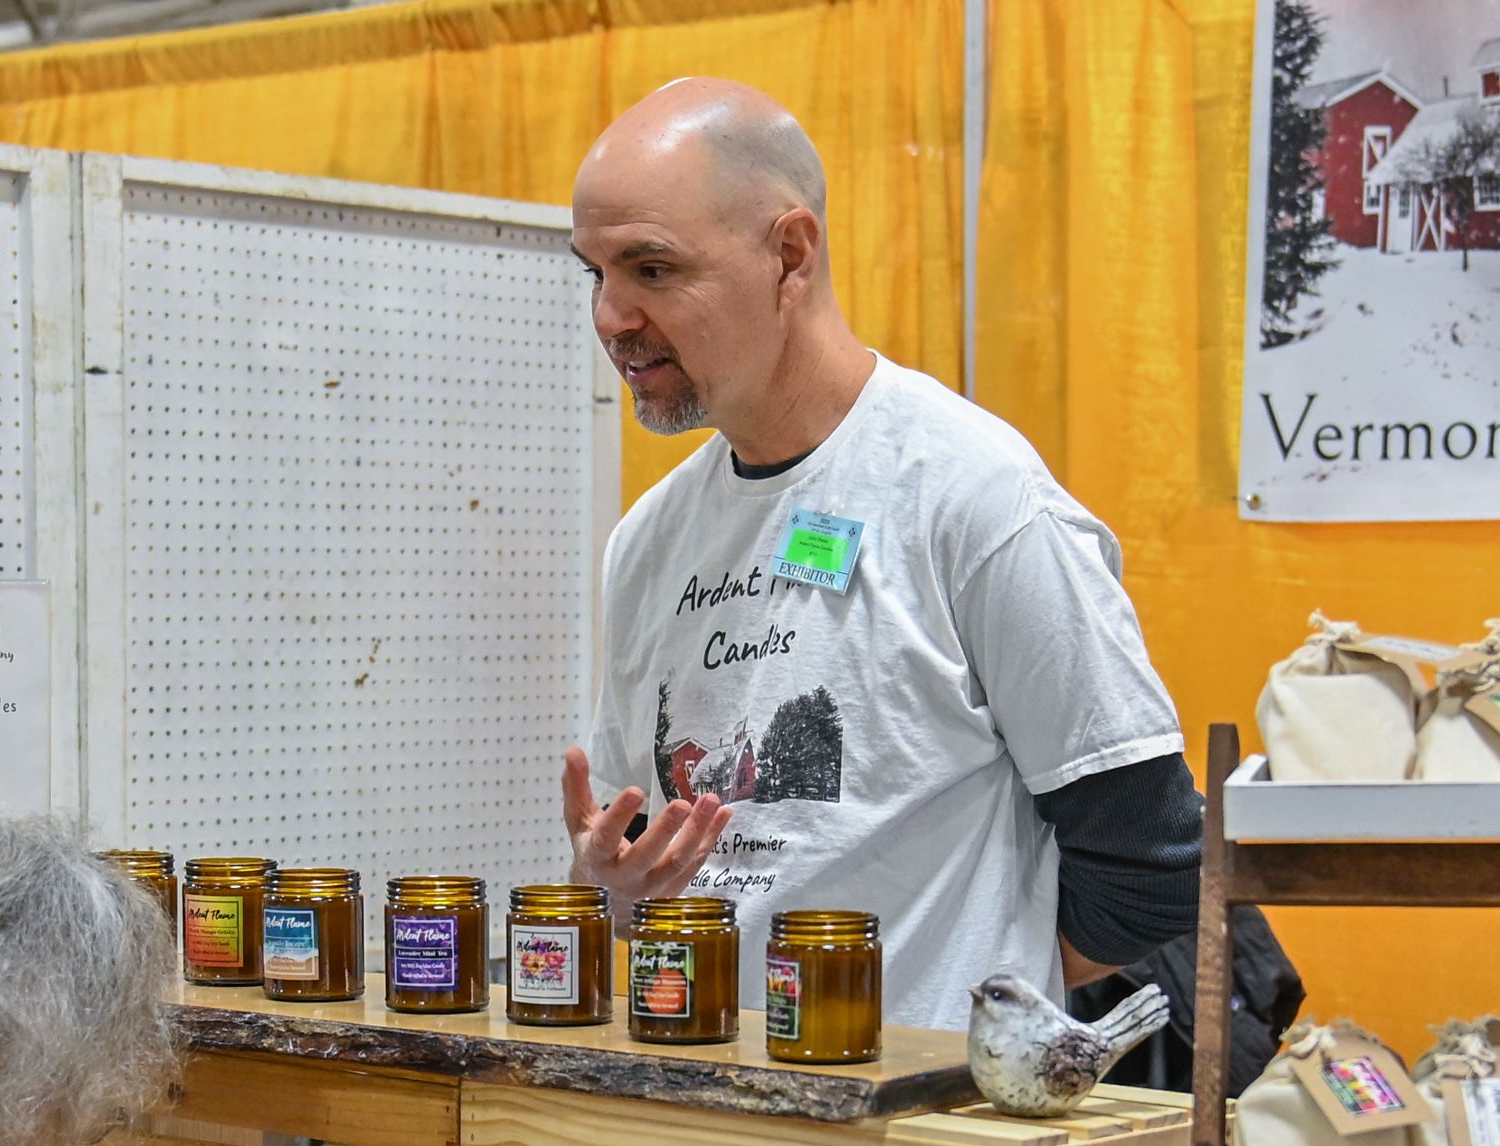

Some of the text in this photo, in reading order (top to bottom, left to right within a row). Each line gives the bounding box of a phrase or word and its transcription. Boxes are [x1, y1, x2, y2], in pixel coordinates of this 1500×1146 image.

[779, 562, 836, 586] EXHIBITOR
[676, 566, 762, 616] Ardent
[733, 833, 787, 854] Premier
[714, 868, 776, 893] Company
